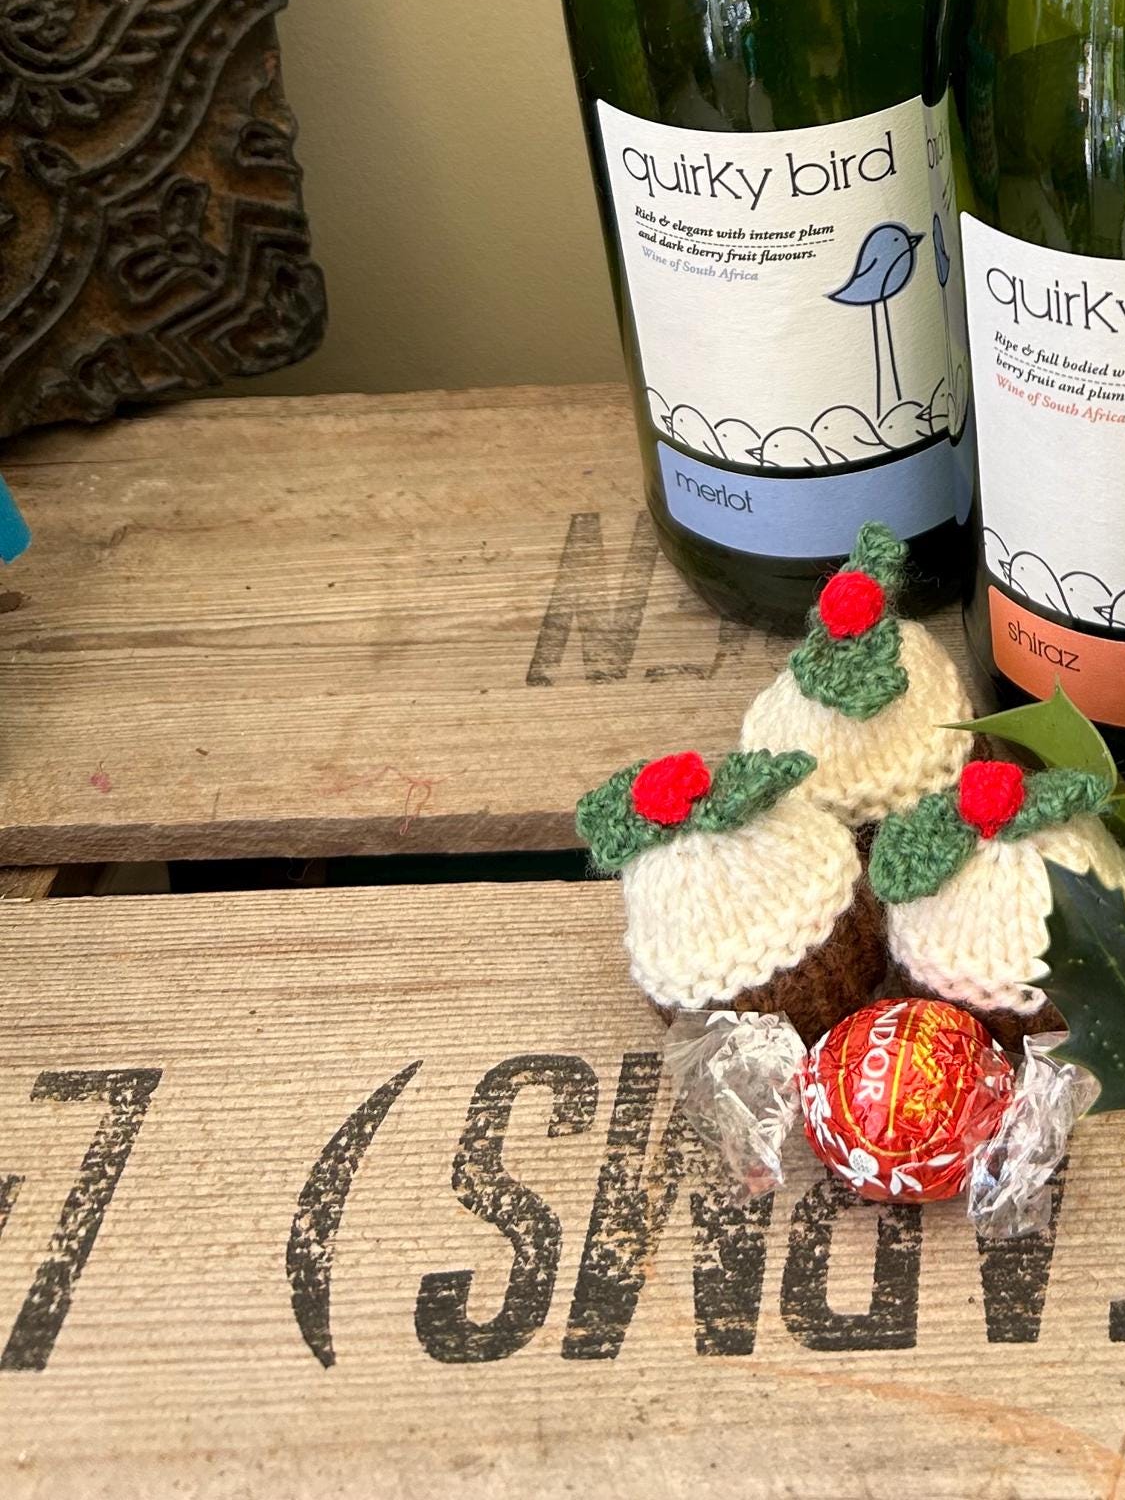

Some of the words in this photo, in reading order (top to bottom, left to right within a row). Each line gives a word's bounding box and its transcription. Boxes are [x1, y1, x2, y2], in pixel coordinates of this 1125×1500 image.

[622, 146, 773, 211] quirky
[786, 130, 897, 198] bird
[635, 205, 656, 227] Rich
[658, 214, 671, 228] &
[672, 219, 714, 238] elegant
[716, 226, 746, 241] with
[749, 227, 796, 241] intense
[798, 223, 835, 242] plum
[638, 229, 657, 245] and
[658, 235, 684, 253] dark
[686, 243, 724, 263] cherry
[724, 248, 758, 263] fruit
[757, 248, 817, 265] flavours.
[641, 245, 667, 265] Wine
[669, 258, 683, 273] of
[682, 262, 717, 278] South
[718, 267, 759, 282] Africa
[994, 330, 1018, 352] Ripe
[1021, 343, 1035, 357] &
[1033, 349, 1060, 367] full
[1062, 352, 1109, 377] bodied
[995, 354, 1025, 379] berry
[1024, 369, 1056, 389] fruit
[1058, 380, 1085, 397] and
[1087, 388, 1125, 405] plum
[995, 372, 1025, 398] Wine
[1027, 391, 1043, 408] of
[1041, 395, 1080, 417] South
[675, 469, 753, 514] merlot
[1007, 619, 1081, 673] shiraz
[858, 1001, 909, 1101] NDOR
